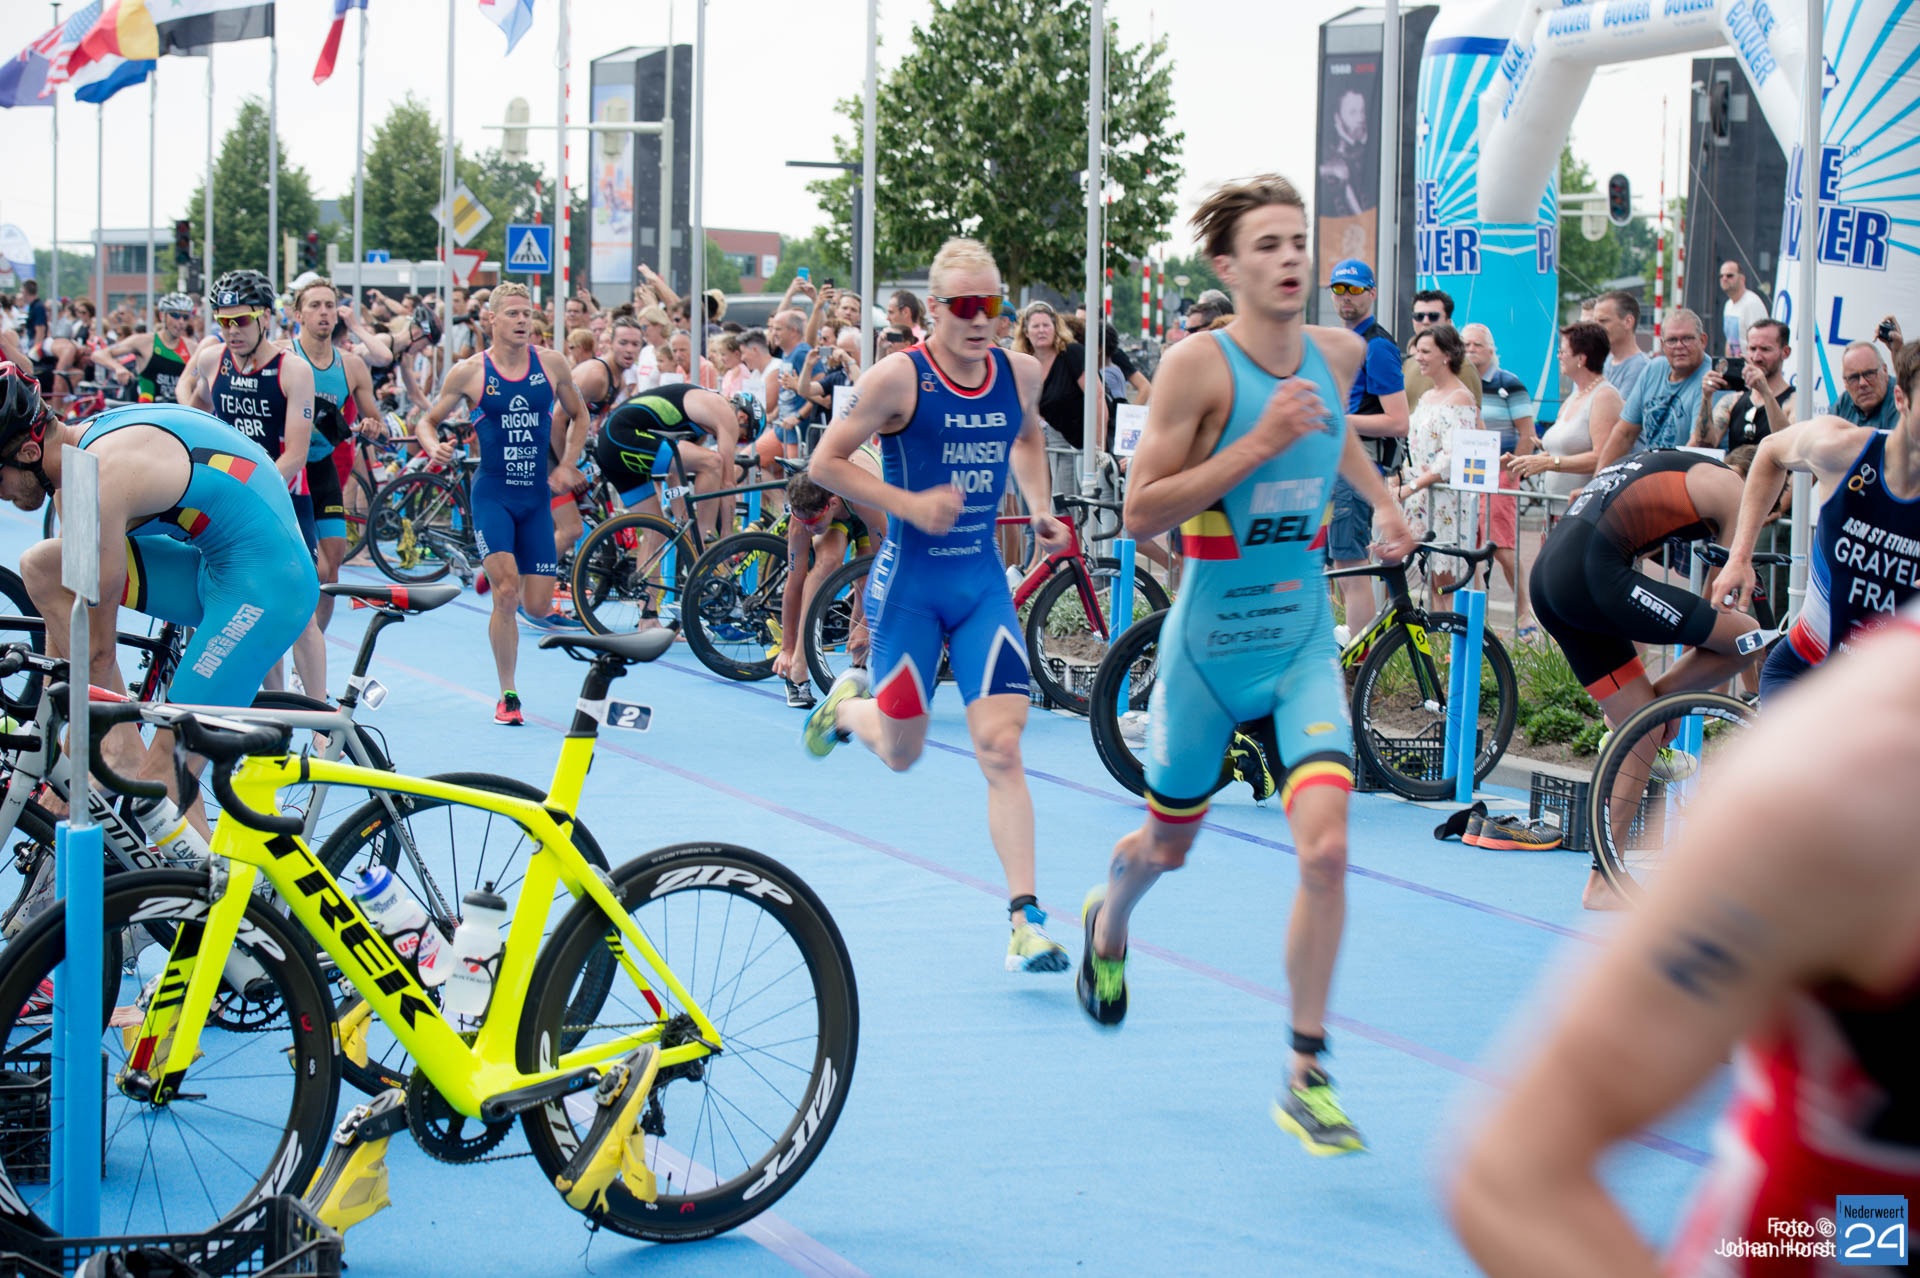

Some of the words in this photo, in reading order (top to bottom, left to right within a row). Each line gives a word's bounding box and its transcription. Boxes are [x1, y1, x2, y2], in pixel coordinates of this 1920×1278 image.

[220, 394, 272, 417] TEAGLE
[234, 418, 266, 437] GBR
[501, 412, 539, 429] RIGONI
[944, 412, 1007, 428] HUUB
[508, 430, 533, 443] ITA
[942, 441, 1007, 464] HANSEN
[951, 470, 994, 493] NOR
[1243, 515, 1315, 546] BEL
[1842, 517, 1871, 540] ASM
[1867, 526, 1888, 546] ST
[1835, 537, 1920, 590] GRAYEL
[1631, 585, 1683, 627] FORTE
[1848, 576, 1896, 617] FRA
[221, 603, 264, 642] RACER
[1340, 608, 1398, 669] OTT
[1745, 635, 1756, 650] 5
[366, 684, 378, 701] 4
[617, 705, 641, 728] 2
[650, 864, 794, 906] ZIPP
[264, 834, 440, 1031] TREK
[743, 1056, 838, 1201] ZIPP
